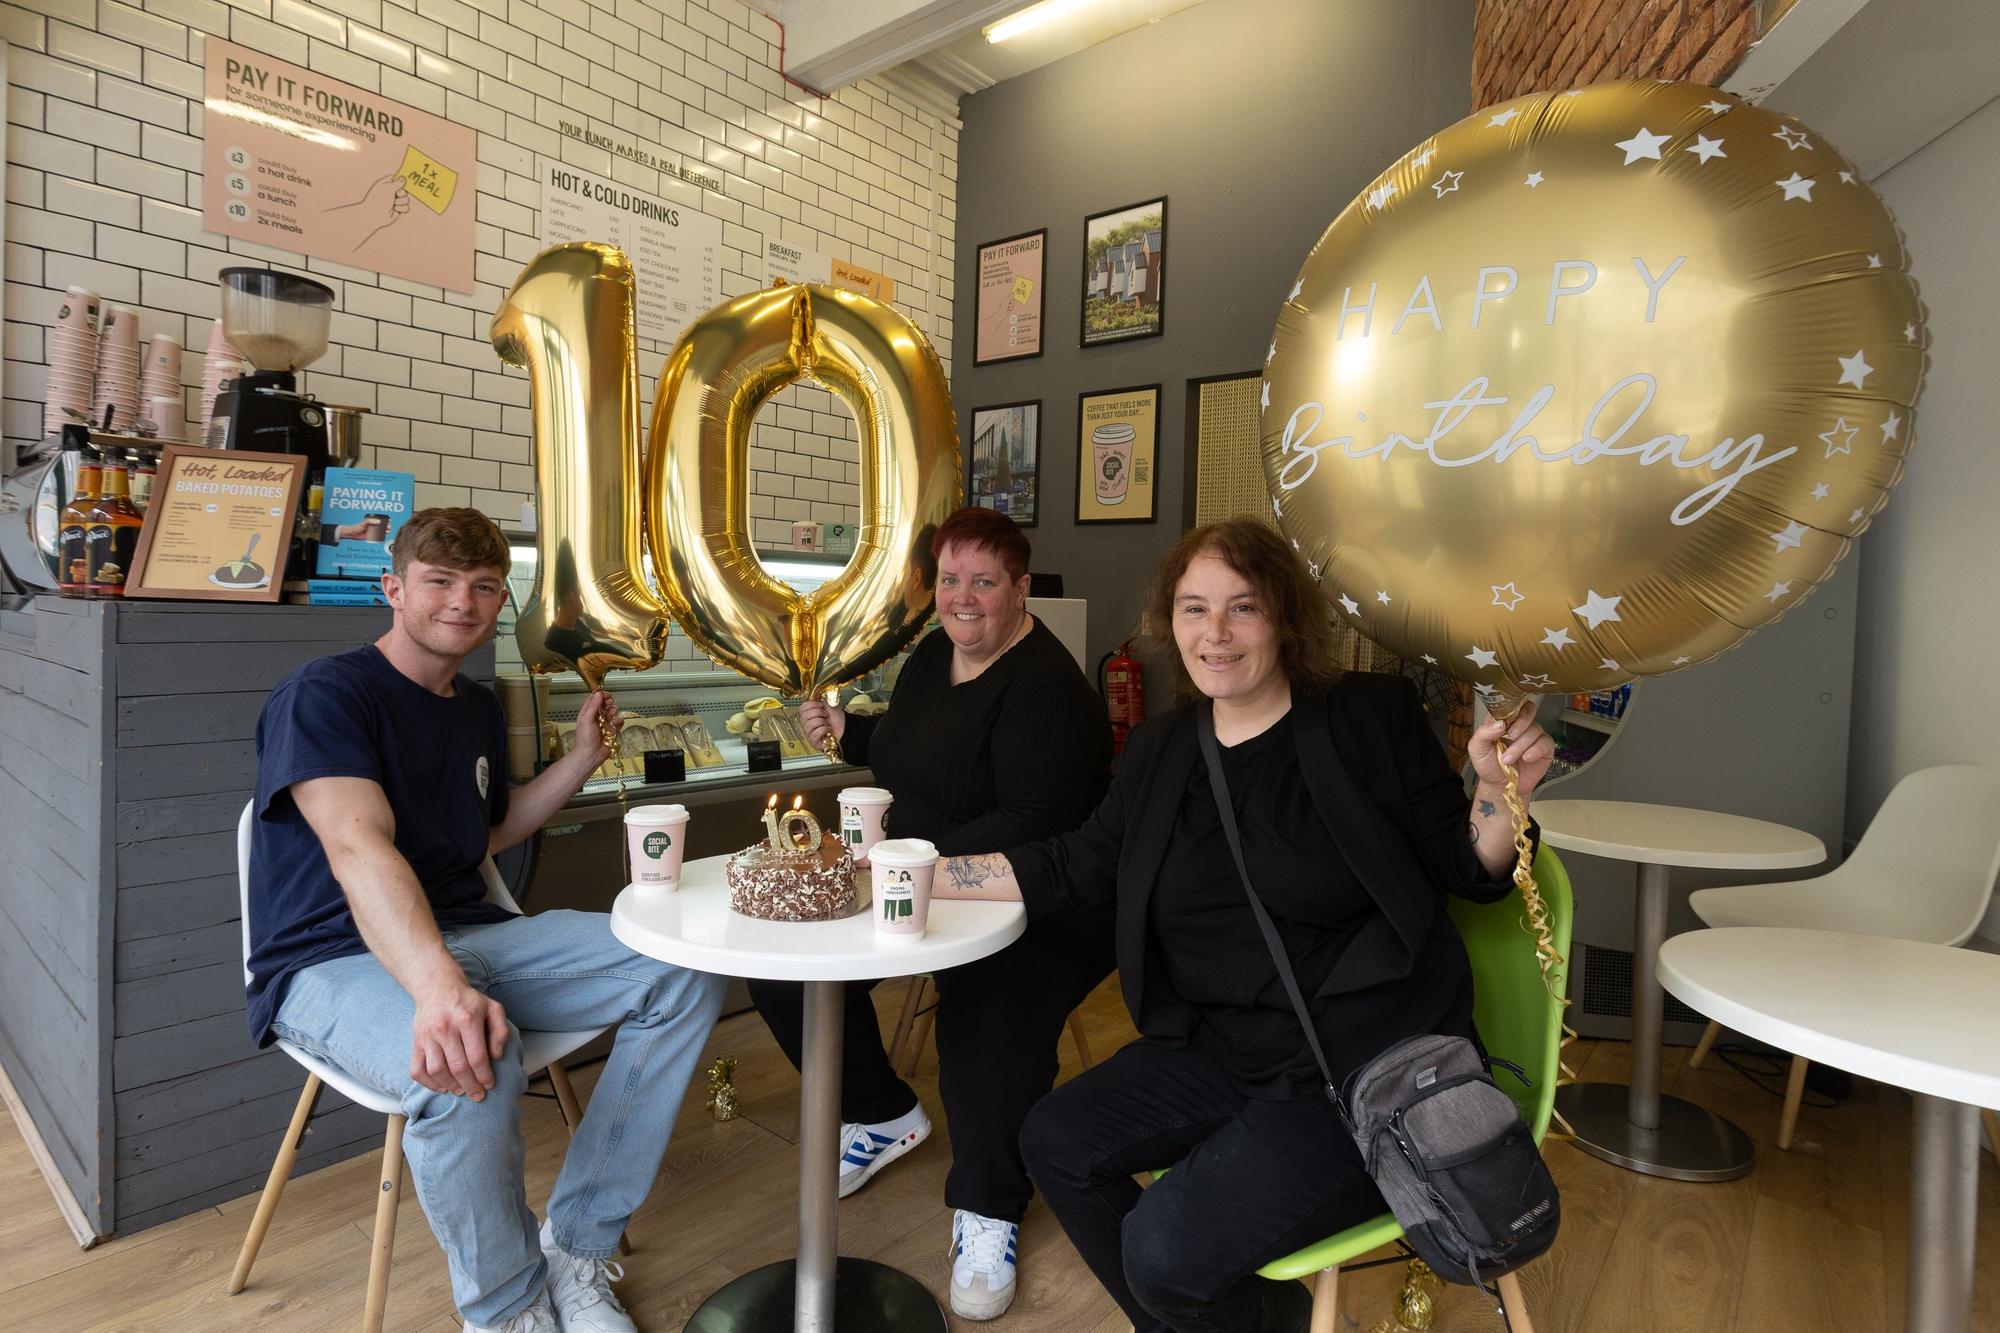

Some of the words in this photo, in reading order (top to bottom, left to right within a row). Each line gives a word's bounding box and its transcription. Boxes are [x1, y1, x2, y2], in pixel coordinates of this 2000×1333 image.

[225, 57, 269, 92] PAY
[277, 75, 297, 101] IT
[303, 83, 404, 138] FORWARD
[225, 82, 242, 96] for
[245, 91, 303, 116] someone
[304, 110, 376, 143] experiencing
[558, 119, 582, 138] YOUR
[585, 130, 613, 151] LUNCH
[616, 144, 649, 164] MAKES
[650, 155, 657, 168] A
[659, 159, 678, 175] REAL
[231, 152, 244, 164] £3
[231, 178, 244, 190] £5
[257, 166, 265, 174] a
[267, 167, 285, 179] hot
[286, 174, 312, 187] drink
[408, 170, 440, 198] MEAL
[257, 191, 265, 199] a
[267, 193, 296, 207] lunch
[550, 197, 584, 212] AMERICANO
[551, 168, 581, 194] HOT
[582, 179, 592, 199] &
[594, 183, 630, 211] COLD
[632, 196, 680, 227] DRINKS
[228, 204, 246, 217] £10
[549, 207, 565, 217] LATTE
[257, 216, 269, 226] 2x
[271, 220, 304, 235] meals
[549, 218, 587, 235] CAPPUCCINO
[639, 225, 652, 234] ICED
[652, 229, 666, 239] LATTE
[639, 235, 659, 247] VANILLA
[639, 246, 652, 255] ICED
[769, 242, 801, 261] BREAKFAST
[983, 249, 996, 262] PAY
[998, 247, 1005, 259] IT
[1005, 239, 1040, 257] FORWARD
[639, 257, 650, 265] HOT
[650, 260, 680, 273] CHOCOLATE
[639, 267, 665, 279] BREAKFAST
[850, 272, 872, 287] Loaded
[1336, 256, 1687, 341] HAPPY
[1087, 404, 1105, 413] COFFEE
[1106, 402, 1120, 411] THAT
[1120, 400, 1136, 409] FUELS
[1136, 398, 1152, 407] MORE
[1087, 412, 1101, 421] THAN
[1101, 411, 1113, 420] JUST
[1114, 409, 1128, 418] YOUR
[1279, 372, 1798, 526] Birthday
[181, 462, 219, 480] Hot,
[224, 465, 292, 483] Loaded
[176, 480, 217, 494] BAKED
[220, 483, 284, 498] POTATOES
[332, 487, 387, 500] PAYING
[391, 490, 404, 502] IT
[329, 498, 405, 513] FORWARD
[761, 808, 822, 852] 10
[647, 837, 668, 846] SOCIAL
[647, 845, 660, 854] BITE
